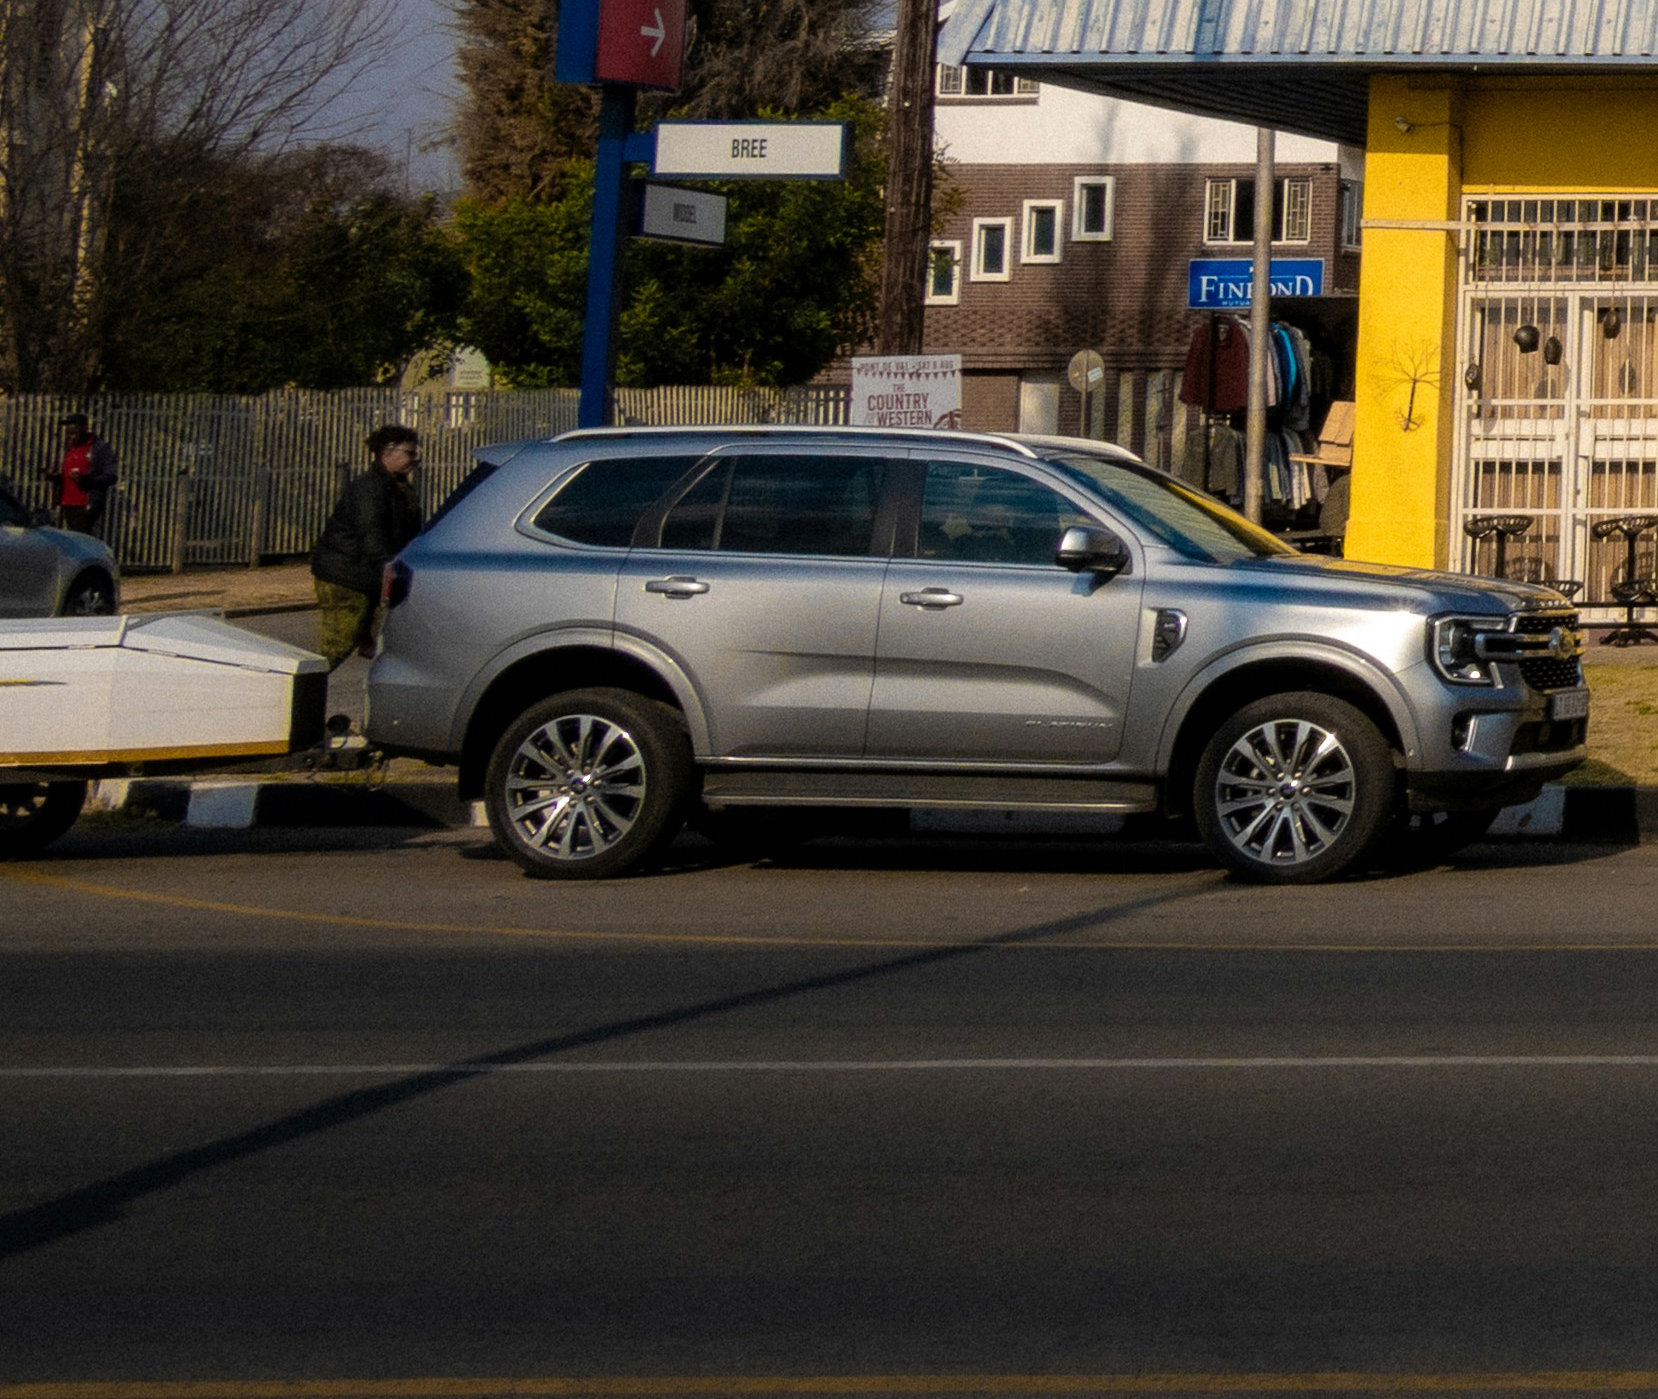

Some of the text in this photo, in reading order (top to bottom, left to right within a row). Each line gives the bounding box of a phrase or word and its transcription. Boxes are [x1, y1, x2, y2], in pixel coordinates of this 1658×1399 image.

[731, 138, 768, 159] BREE
[893, 383, 905, 392] THE
[867, 393, 930, 411] COUNTRY
[876, 410, 933, 427] WESTERN
